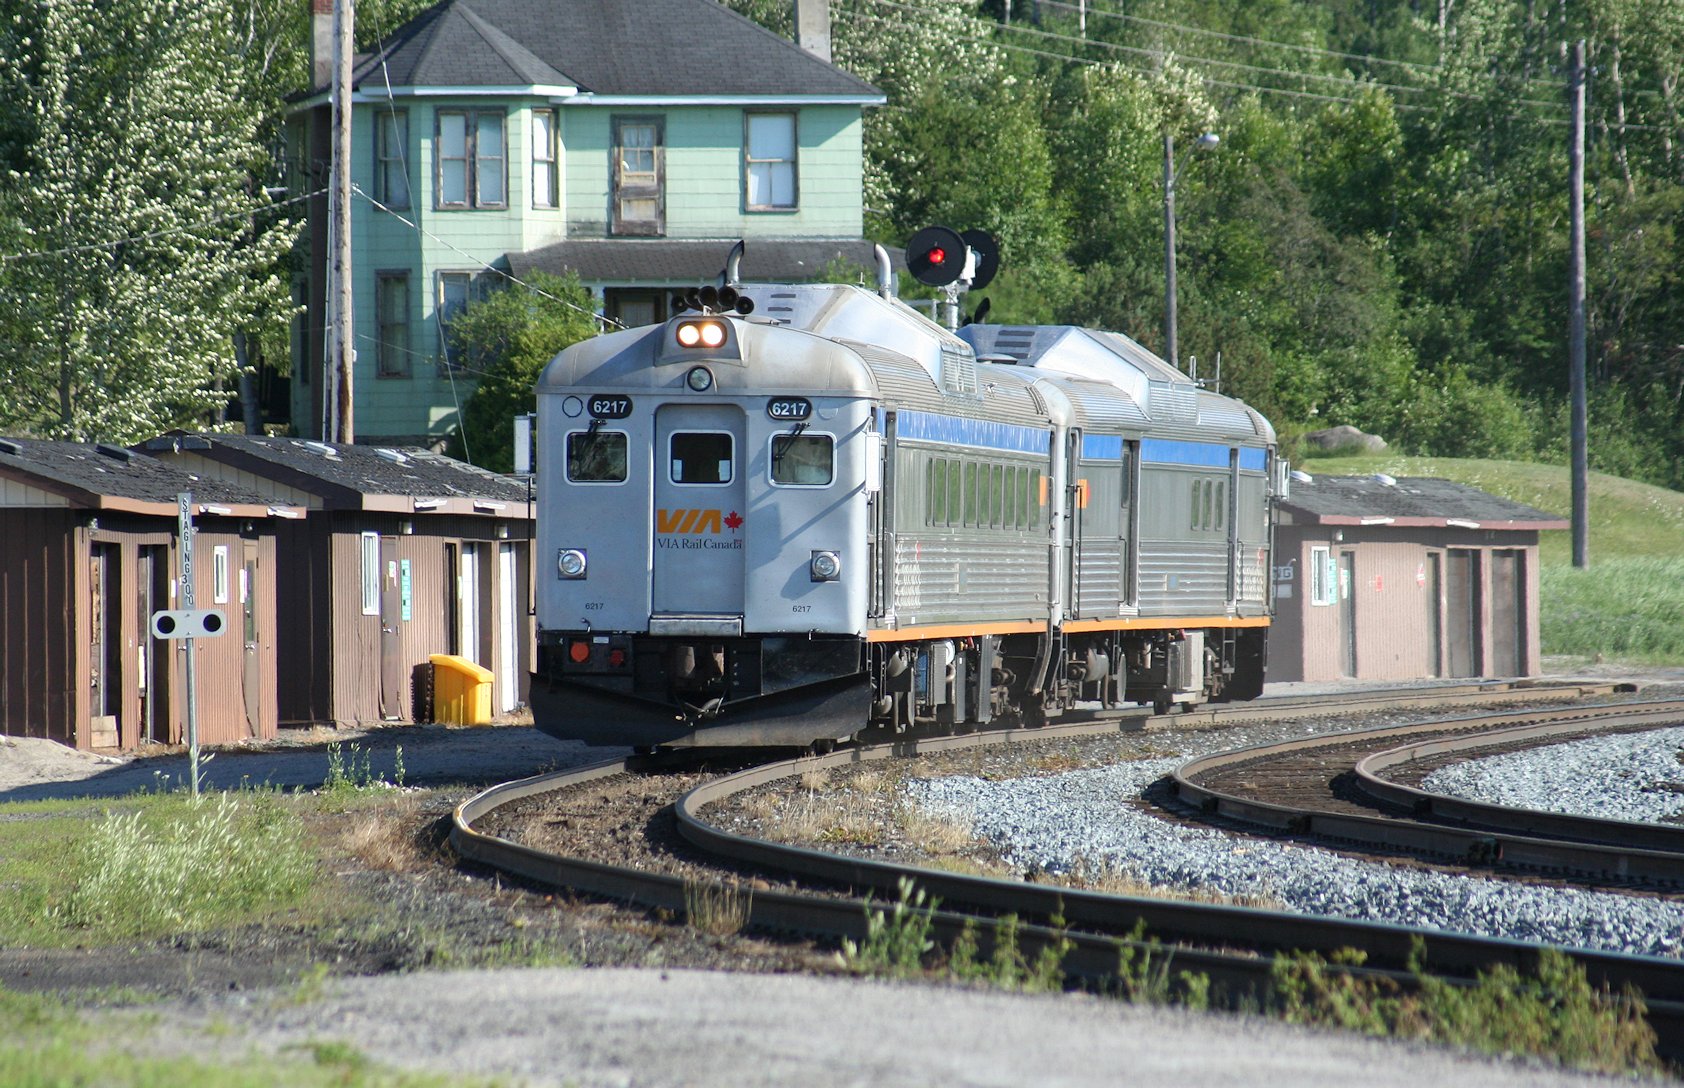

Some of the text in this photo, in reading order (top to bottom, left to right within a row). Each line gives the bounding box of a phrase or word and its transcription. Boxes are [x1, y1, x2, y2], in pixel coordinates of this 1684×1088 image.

[593, 400, 627, 413] 6217
[772, 402, 807, 416] 6217
[657, 509, 721, 534] VIA
[181, 500, 190, 573] STAGING
[658, 538, 742, 549] VIA Rail Canada
[585, 602, 604, 610] 6217
[792, 605, 812, 613] 6217
